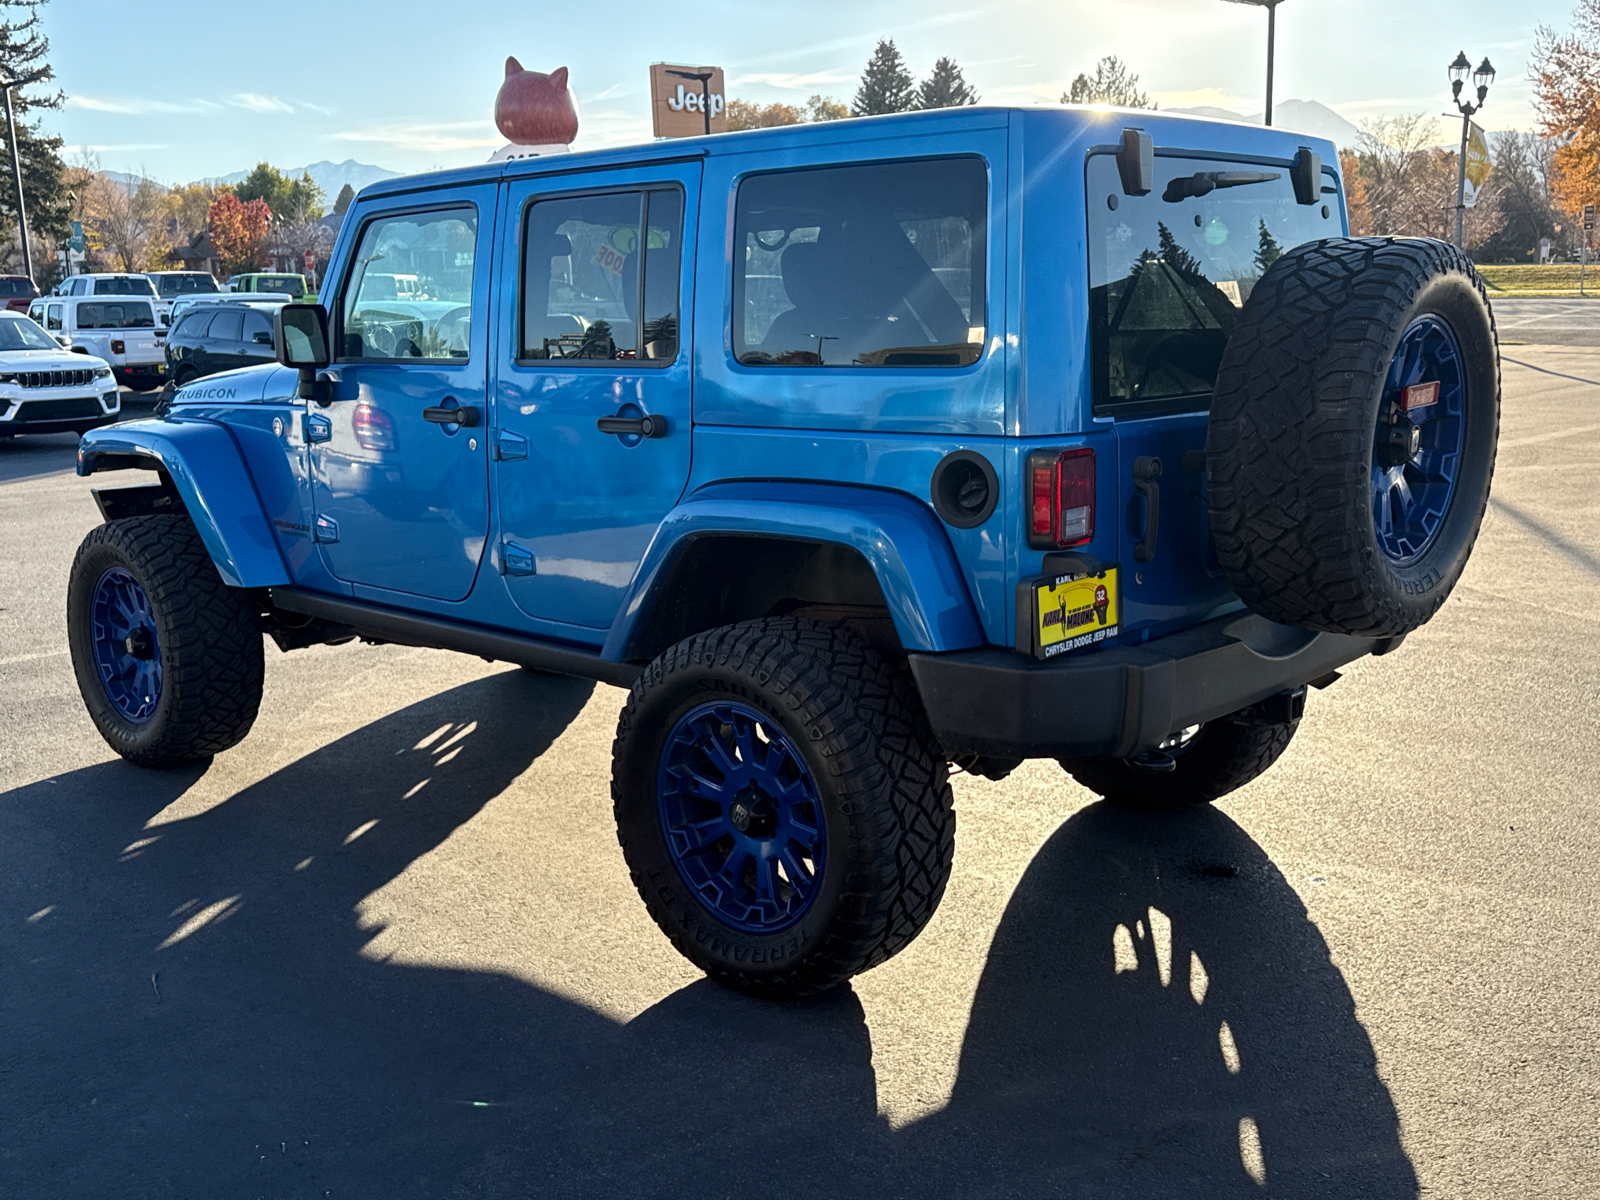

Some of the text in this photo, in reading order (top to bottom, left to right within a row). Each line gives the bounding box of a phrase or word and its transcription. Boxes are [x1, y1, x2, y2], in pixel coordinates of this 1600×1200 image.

[154, 340, 165, 348] Je
[179, 388, 237, 400] RUBICON
[1055, 574, 1072, 586] KARL
[1096, 589, 1105, 601] 32
[1042, 608, 1061, 628] KARL
[1067, 608, 1095, 631] MALONE
[1045, 626, 1118, 657] CHRYSLER DODGE JEEP RAM
[697, 678, 785, 725] SAILUN
[678, 909, 812, 965] TERRAMAX
